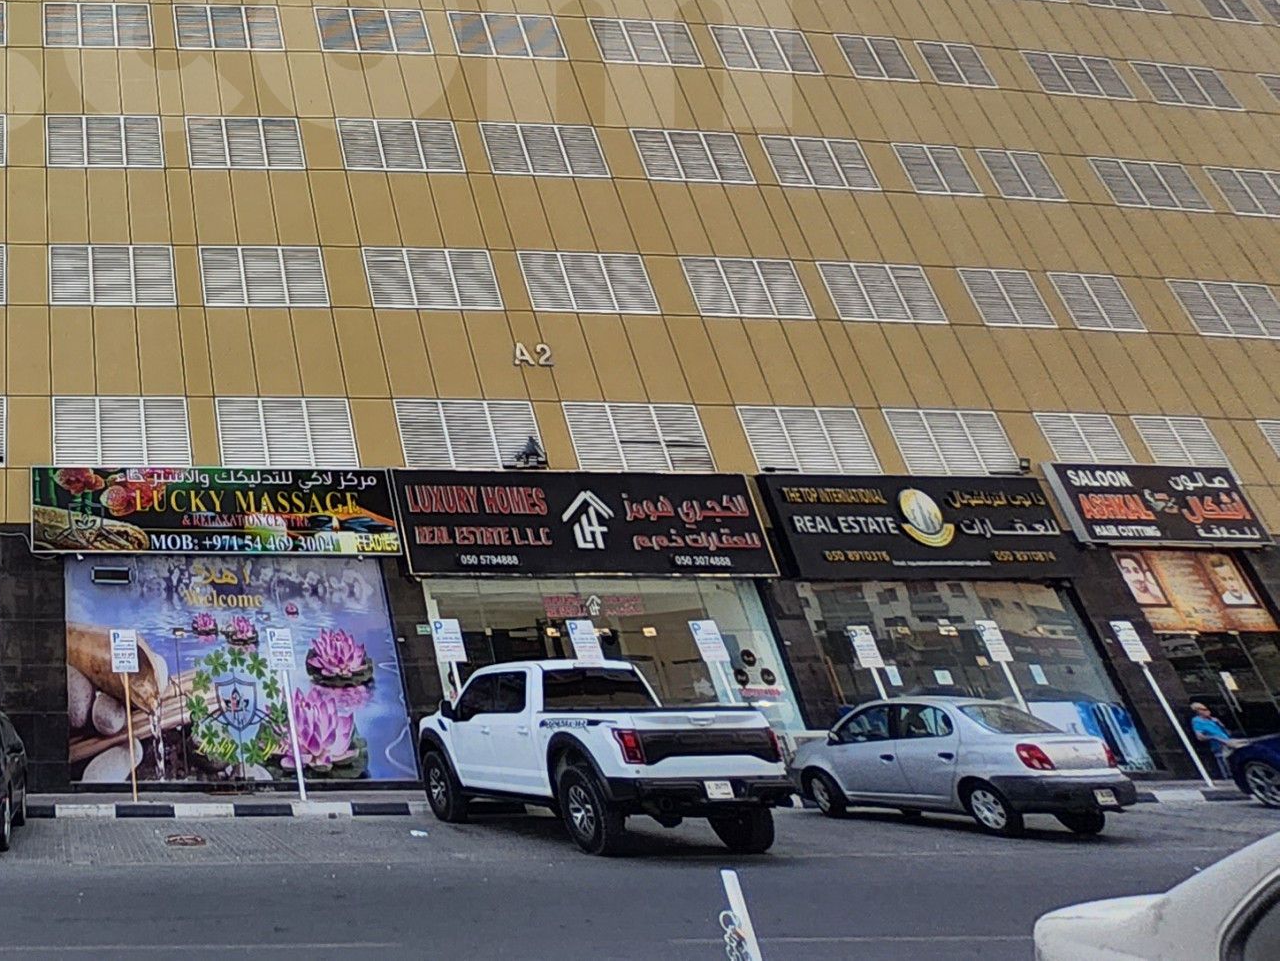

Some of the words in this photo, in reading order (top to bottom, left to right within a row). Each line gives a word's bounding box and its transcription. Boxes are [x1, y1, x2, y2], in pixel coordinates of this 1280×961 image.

[514, 342, 554, 366] A2
[298, 472, 332, 493] لاكي
[339, 472, 377, 490] مركز
[1066, 470, 1134, 487] SALOON
[1167, 471, 1231, 491] صالون
[135, 489, 225, 513] LUCKY
[235, 490, 362, 515] MASSAGE
[404, 485, 480, 513] LUXURY
[481, 486, 548, 516] HOMES
[817, 488, 888, 505] INTERNATIONAL
[1078, 493, 1158, 520] ASHKAL
[182, 514, 192, 526] &
[193, 513, 263, 527] RELAXATION
[266, 514, 311, 527] CENTRE
[793, 515, 839, 533] REAL
[837, 516, 900, 534] ESTATE
[960, 518, 1060, 538] للعقارات
[414, 526, 453, 545] REAL
[454, 526, 512, 545] ESTATE
[1092, 525, 1120, 536] HAIR
[1117, 525, 1162, 537] CUTTING
[150, 534, 199, 551] MOB:
[202, 535, 240, 551] +971
[244, 535, 262, 551] 54
[267, 535, 293, 552] 469
[298, 535, 335, 552] 3004
[461, 555, 478, 565] 050
[675, 555, 692, 566] 050
[184, 589, 264, 608] Welcome
